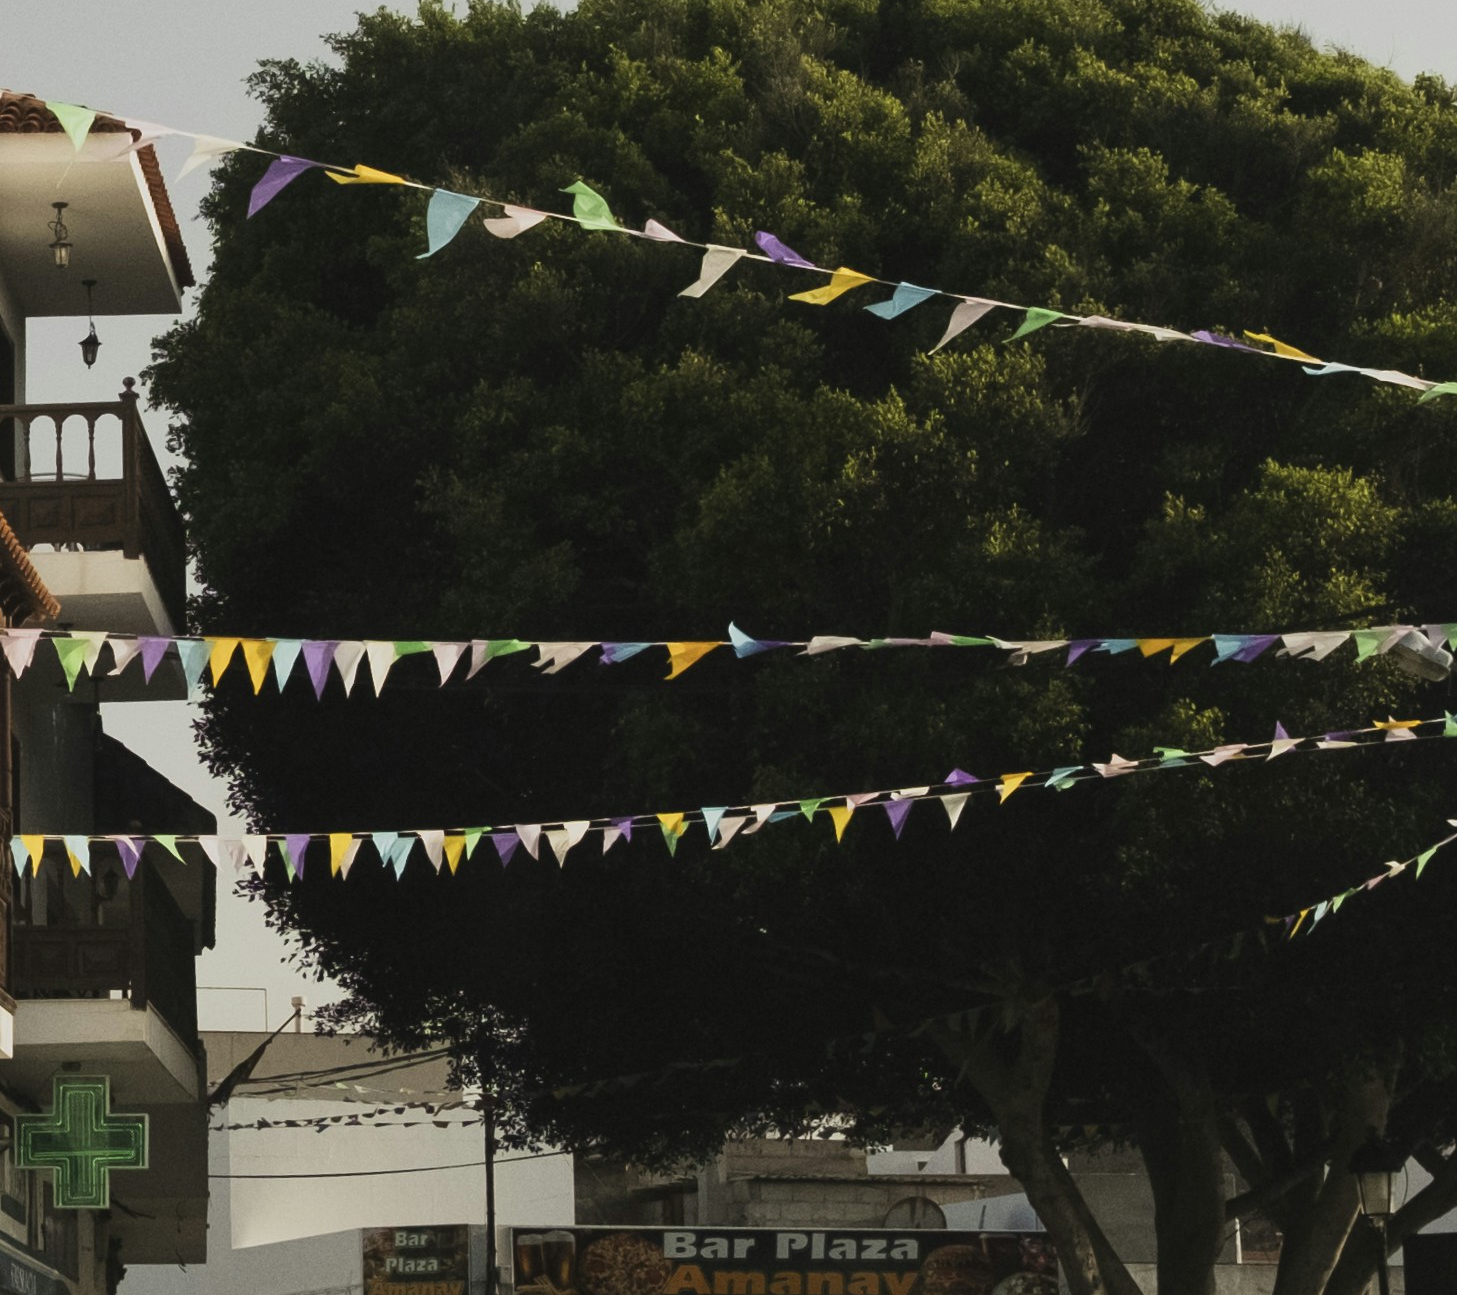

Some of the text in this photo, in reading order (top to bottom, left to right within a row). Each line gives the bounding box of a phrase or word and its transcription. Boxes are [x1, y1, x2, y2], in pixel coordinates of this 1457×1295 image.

[394, 1232, 428, 1247] Bar
[663, 1232, 919, 1260] Bar Plaza
[385, 1258, 438, 1273] Plaza
